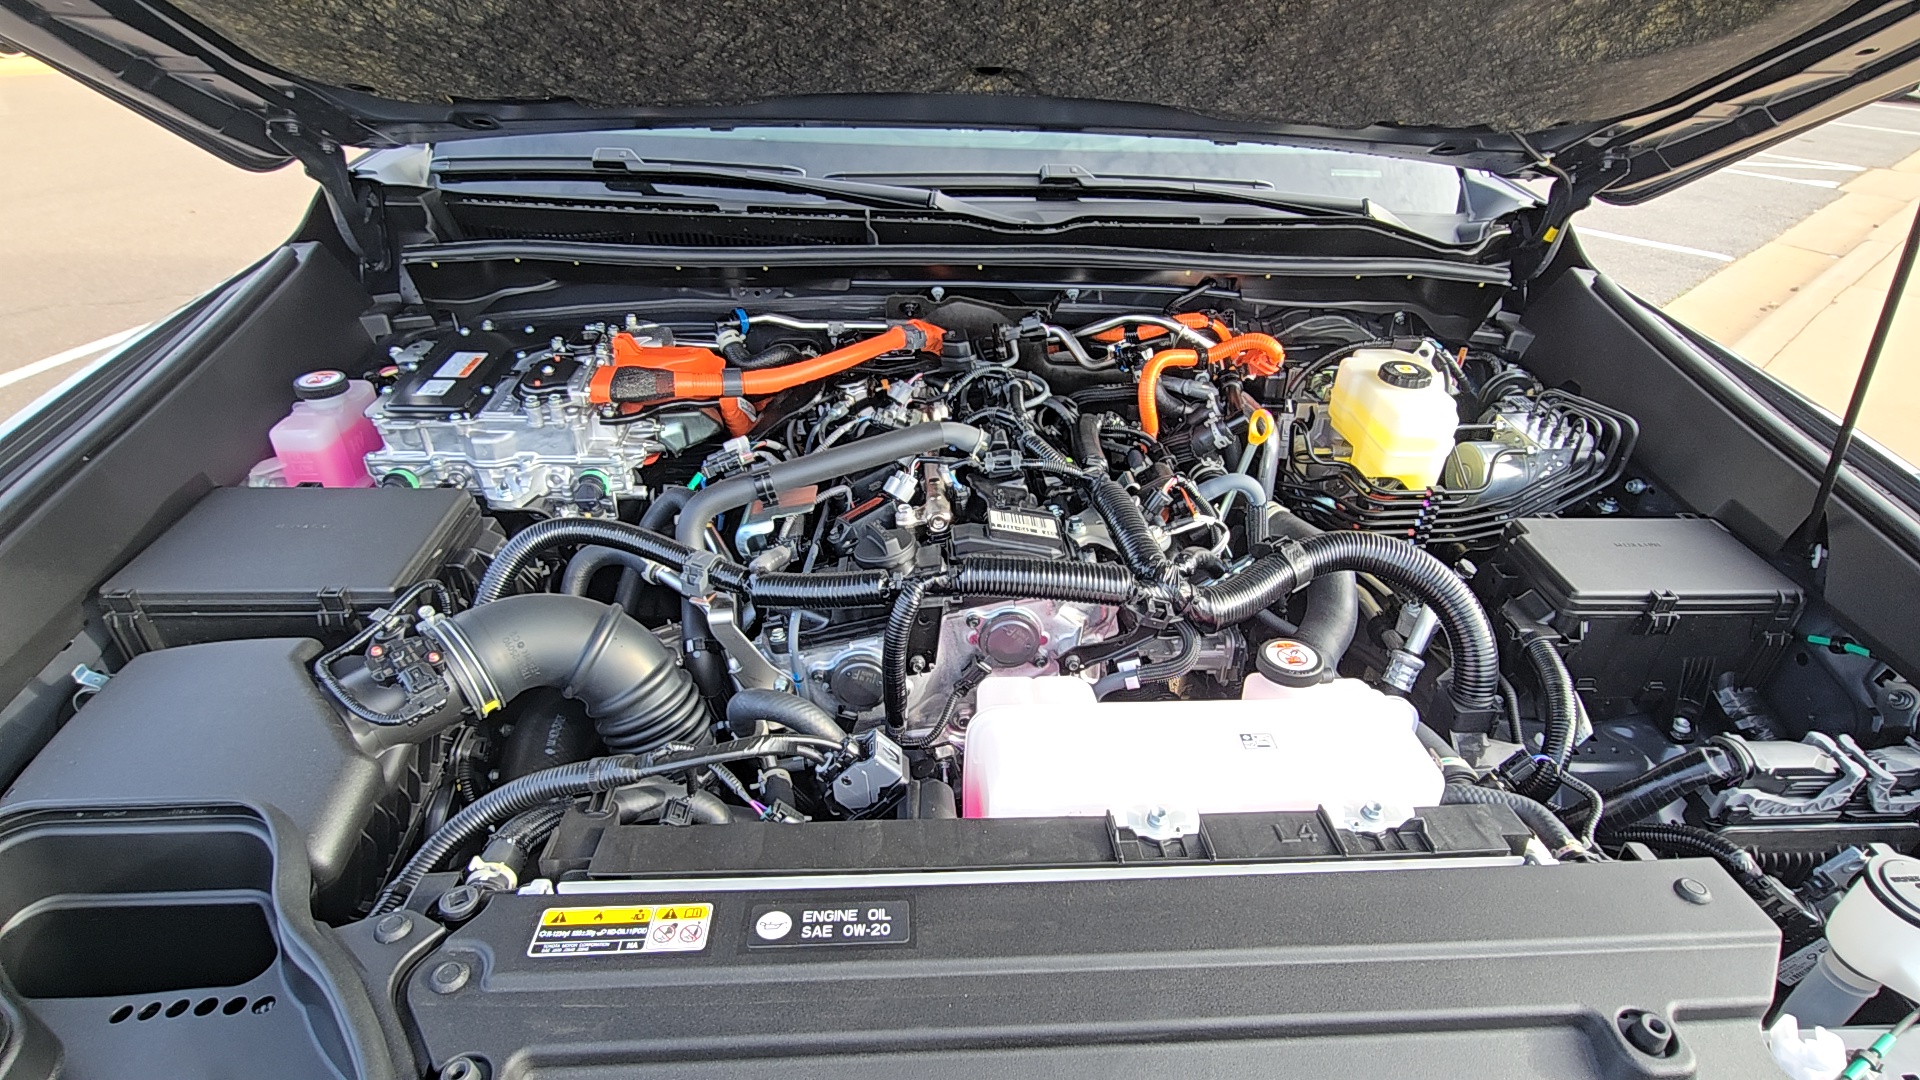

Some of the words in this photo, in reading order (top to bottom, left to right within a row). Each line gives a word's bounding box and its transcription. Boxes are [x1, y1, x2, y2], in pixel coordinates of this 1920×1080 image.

[802, 909, 858, 923] ENGINE
[867, 908, 892, 921] OIL
[801, 924, 833, 938] SAE
[843, 923, 891, 937] 0W-20
